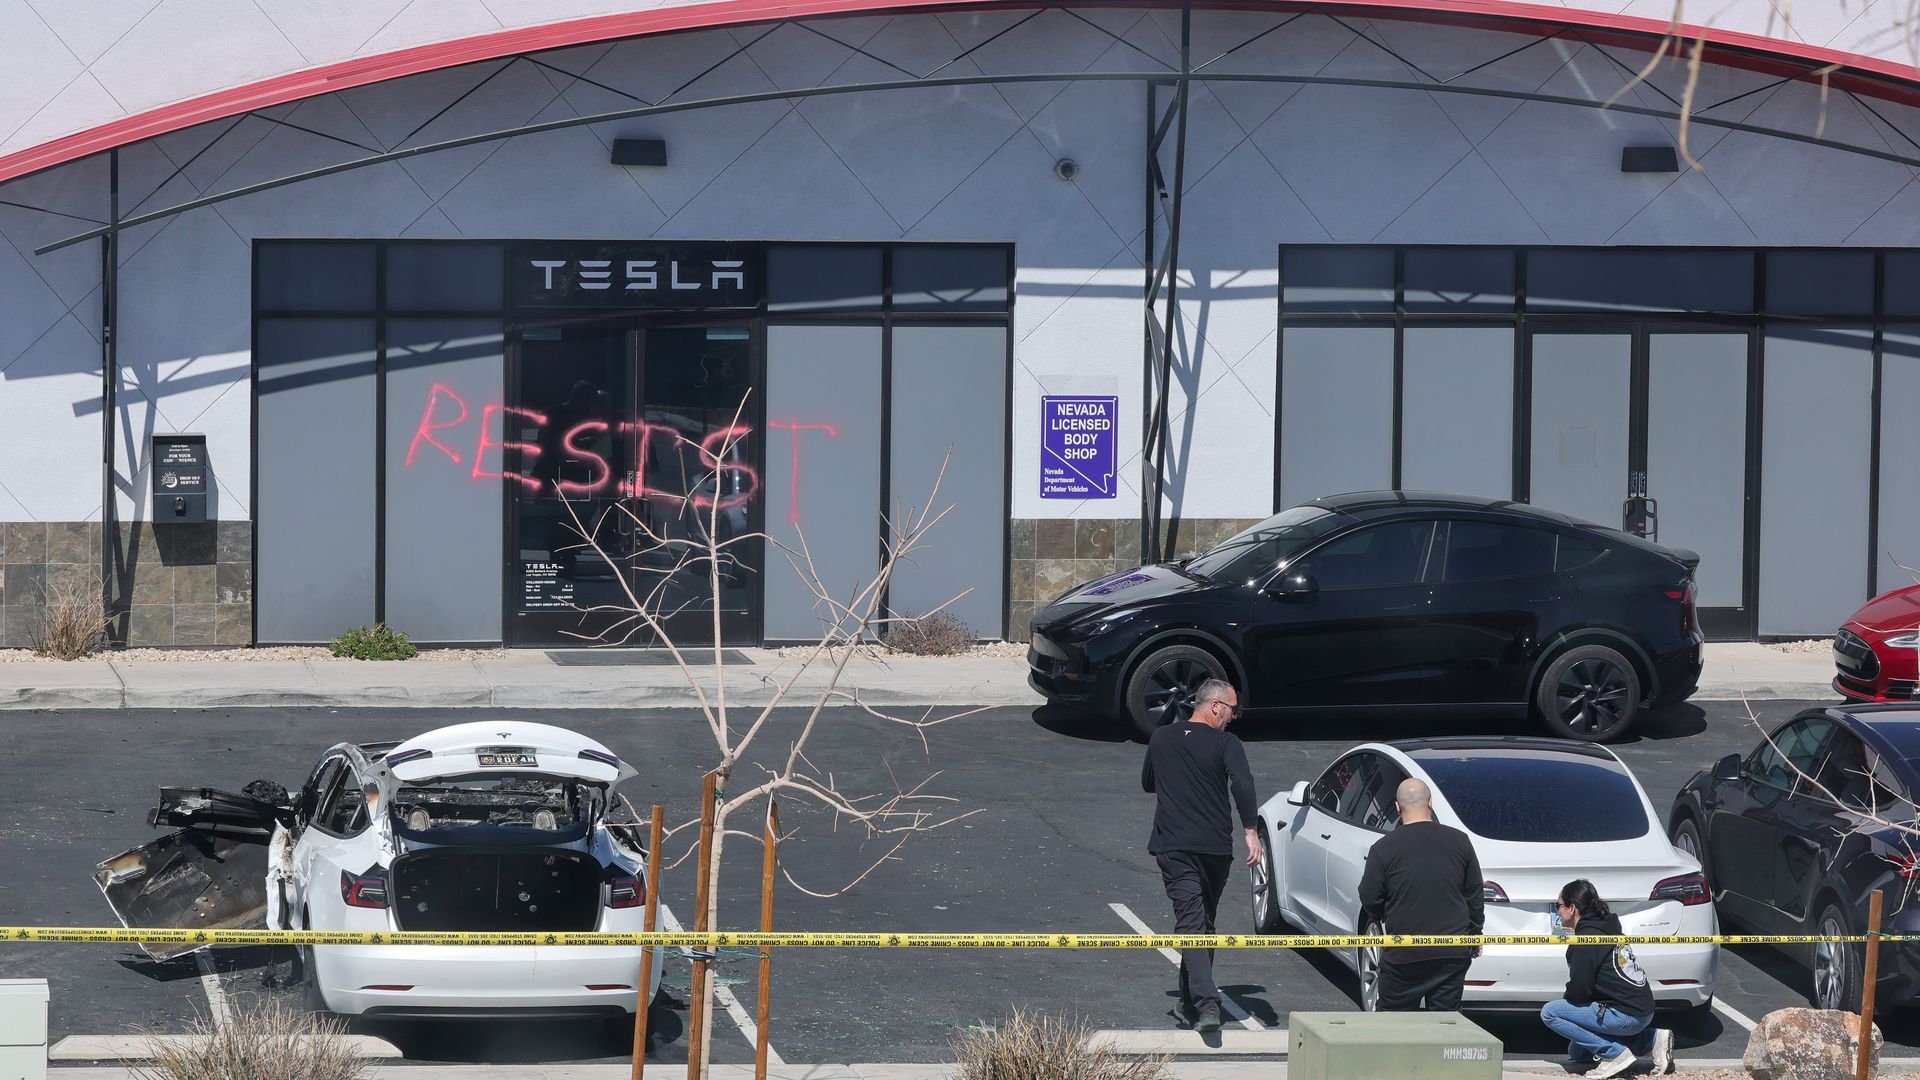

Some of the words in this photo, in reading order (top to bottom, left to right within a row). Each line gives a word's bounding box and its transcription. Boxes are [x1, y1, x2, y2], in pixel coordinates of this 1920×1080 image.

[531, 260, 744, 289] TESLA
[1058, 404, 1106, 416] NEVADA
[1052, 419, 1110, 430] LICENSED
[1064, 434, 1098, 445] BODY
[406, 384, 838, 524] RESIST
[1064, 448, 1097, 459] SHOP
[1318, 938, 1330, 946] NOT
